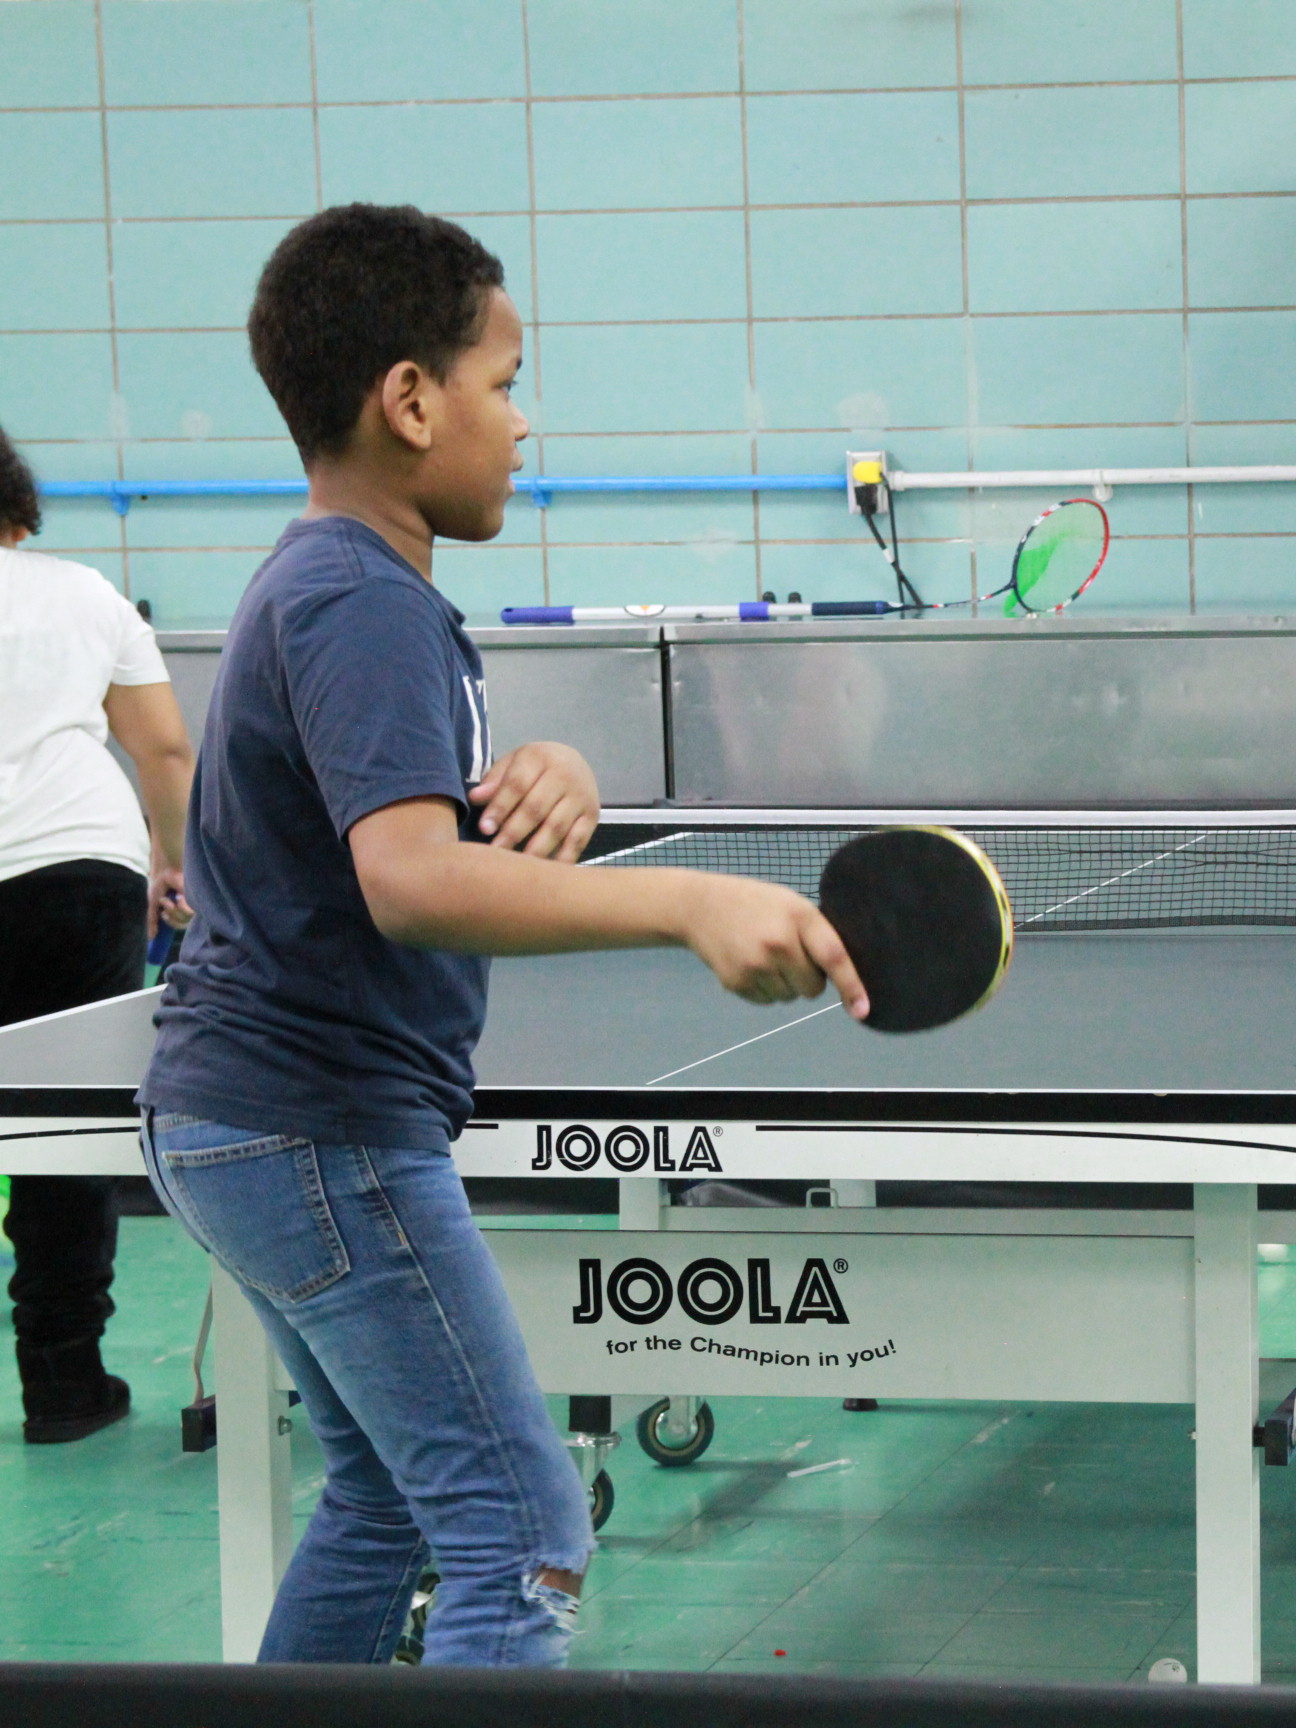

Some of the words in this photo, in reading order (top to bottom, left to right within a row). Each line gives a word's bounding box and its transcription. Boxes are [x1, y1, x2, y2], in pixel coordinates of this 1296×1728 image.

[606, 1339, 638, 1355] for
[645, 1335, 682, 1350] the
[690, 1336, 810, 1367] Champion
[819, 1352, 839, 1367] in
[847, 1339, 897, 1368] you!
